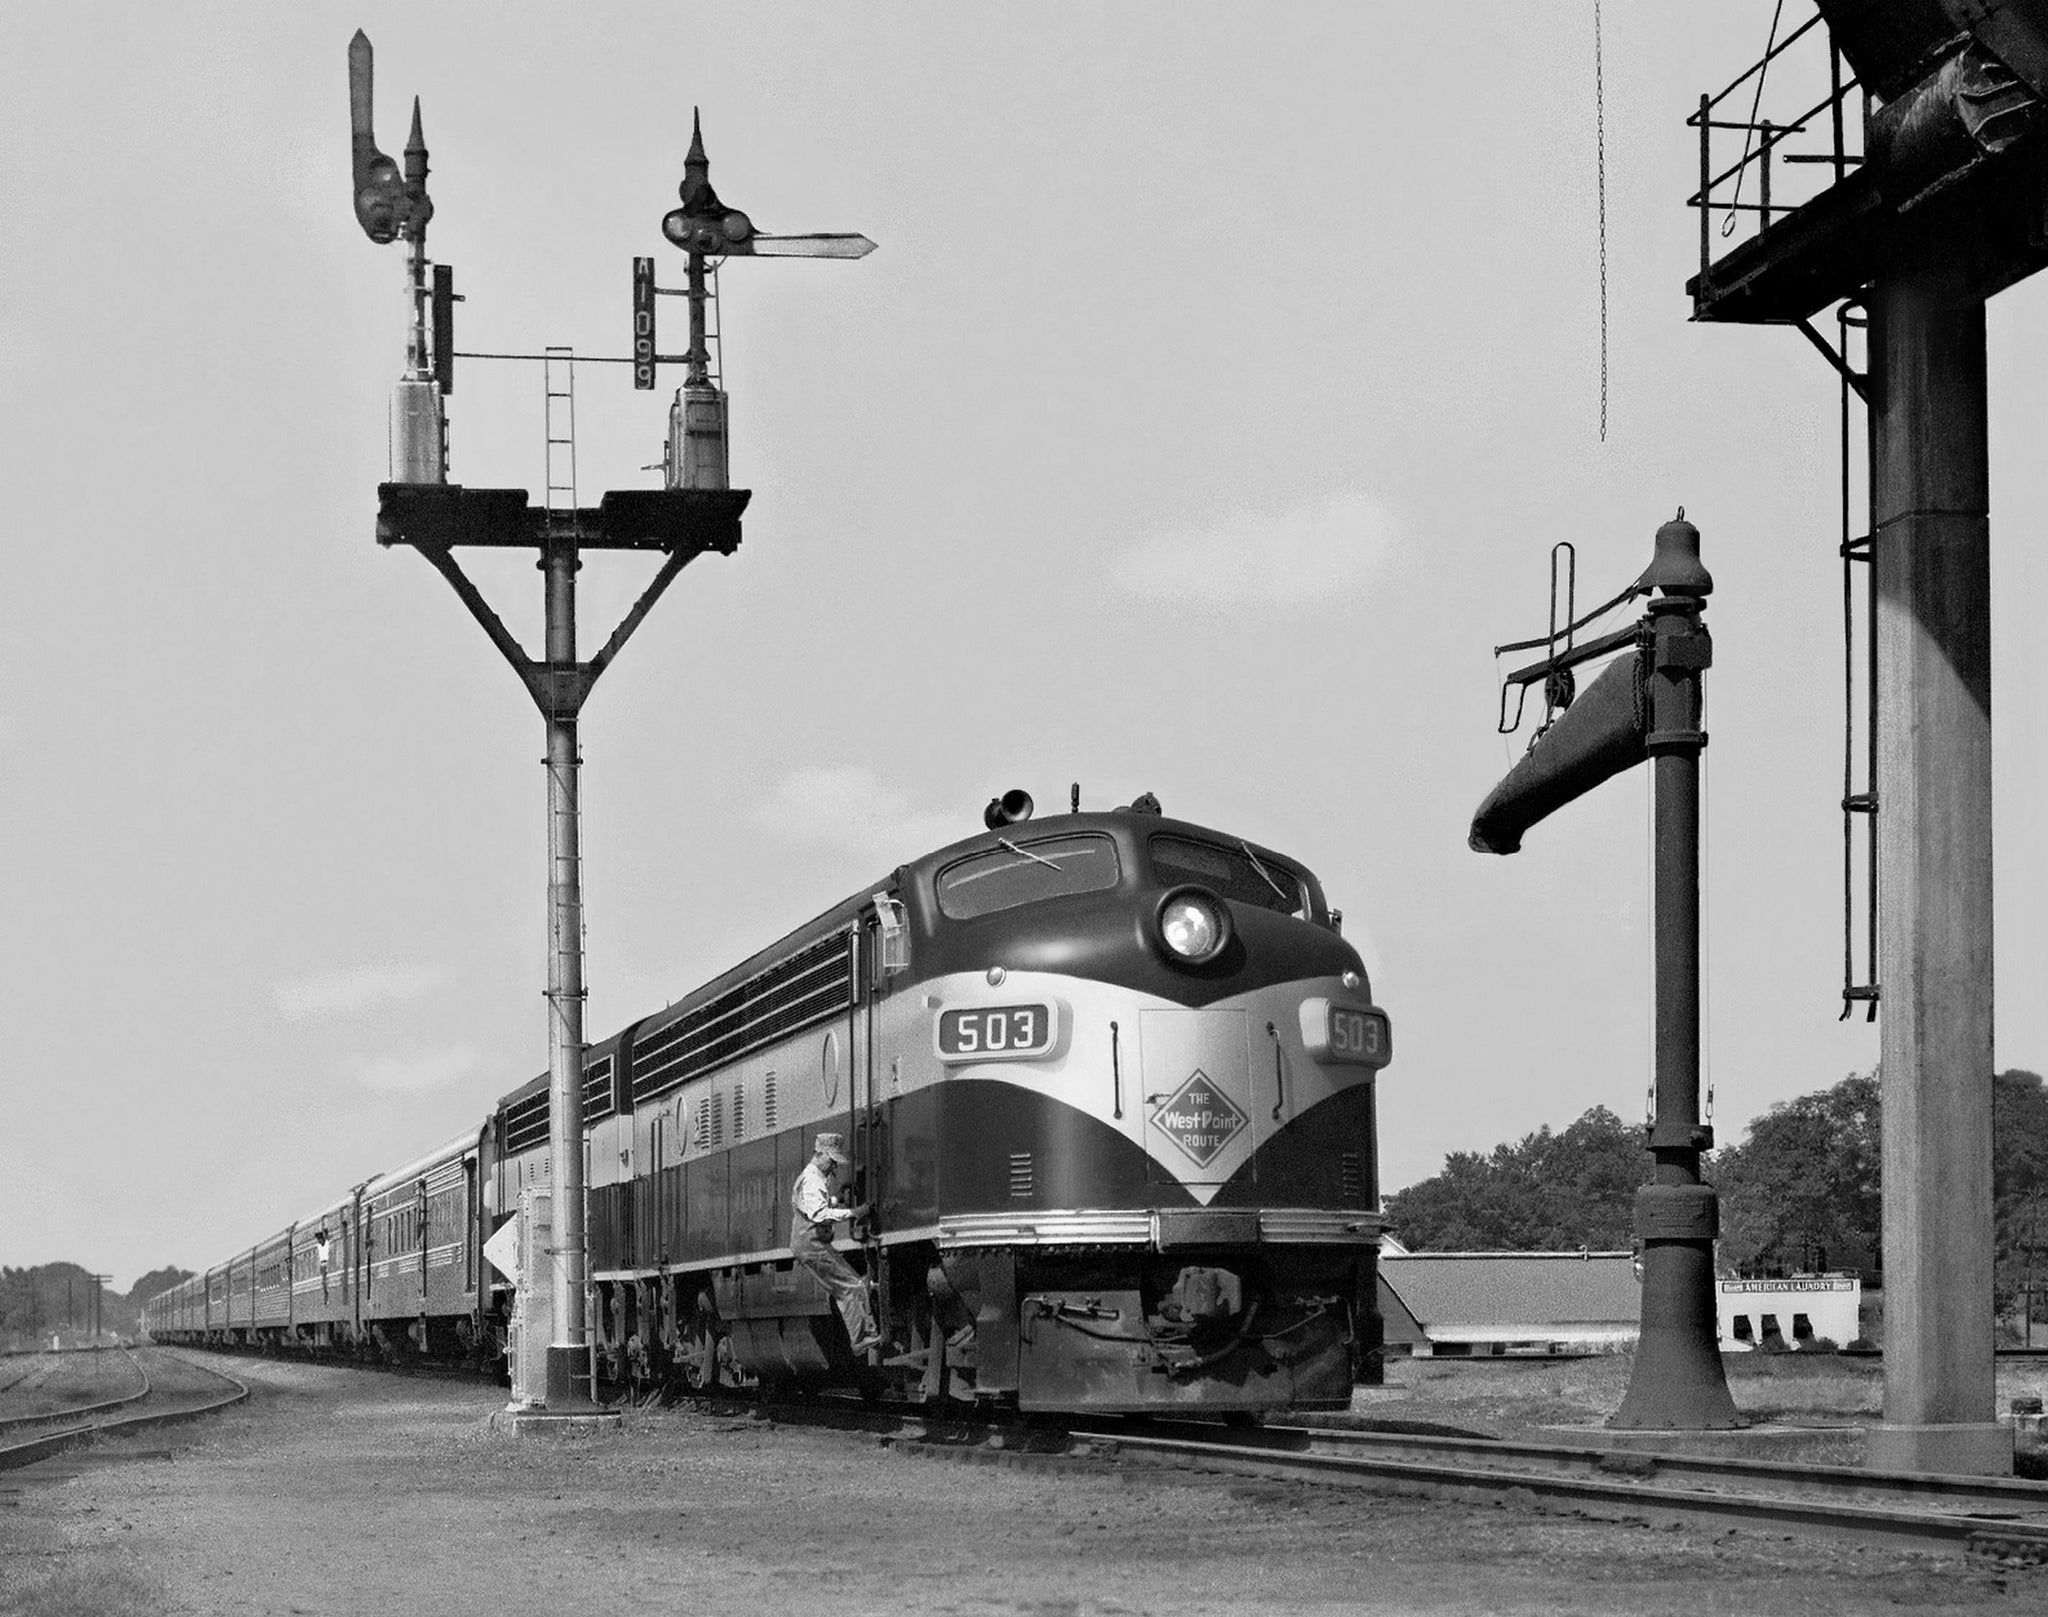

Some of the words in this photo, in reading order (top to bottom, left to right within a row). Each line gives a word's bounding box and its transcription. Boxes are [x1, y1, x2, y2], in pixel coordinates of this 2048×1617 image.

[957, 1010, 1034, 1052] 503
[1334, 1012, 1379, 1053] 503
[1188, 1092, 1210, 1105] THE
[1164, 1110, 1201, 1129] West
[1202, 1110, 1239, 1129] Point
[1182, 1134, 1221, 1147] ROUTE
[1745, 1282, 1789, 1292] AMERICAN
[1790, 1281, 1831, 1292] LAUNDRY
